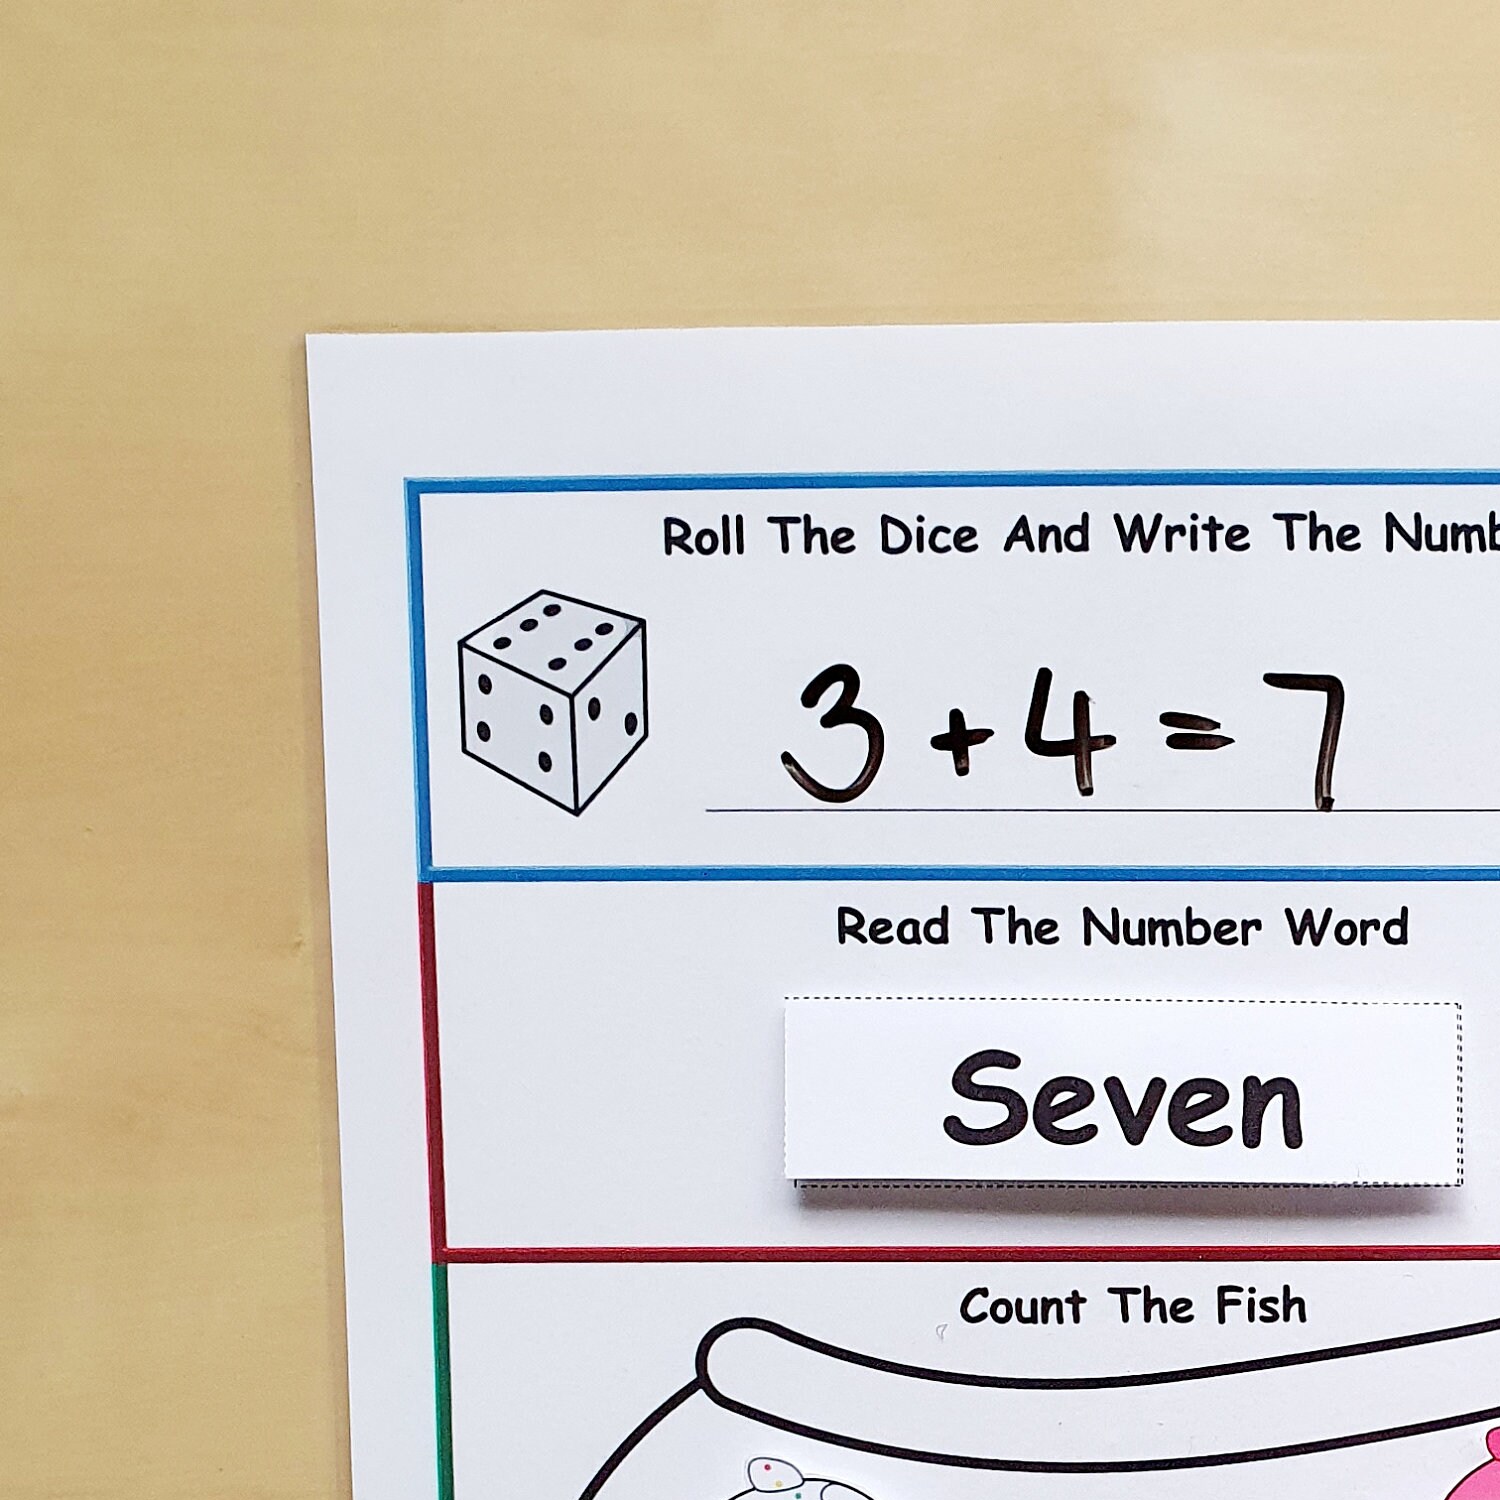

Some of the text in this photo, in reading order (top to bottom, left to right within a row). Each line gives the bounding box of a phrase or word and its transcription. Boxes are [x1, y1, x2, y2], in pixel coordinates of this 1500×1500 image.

[664, 514, 744, 555] Roll
[767, 514, 856, 555] The
[881, 514, 978, 554] Dice
[1004, 512, 1089, 553] And
[1114, 513, 1250, 553] Write
[1273, 511, 1361, 552] The
[838, 905, 1408, 947] Read The Number Word
[943, 1049, 1303, 1149] Seven
[960, 1285, 1306, 1324] Count The Fish
